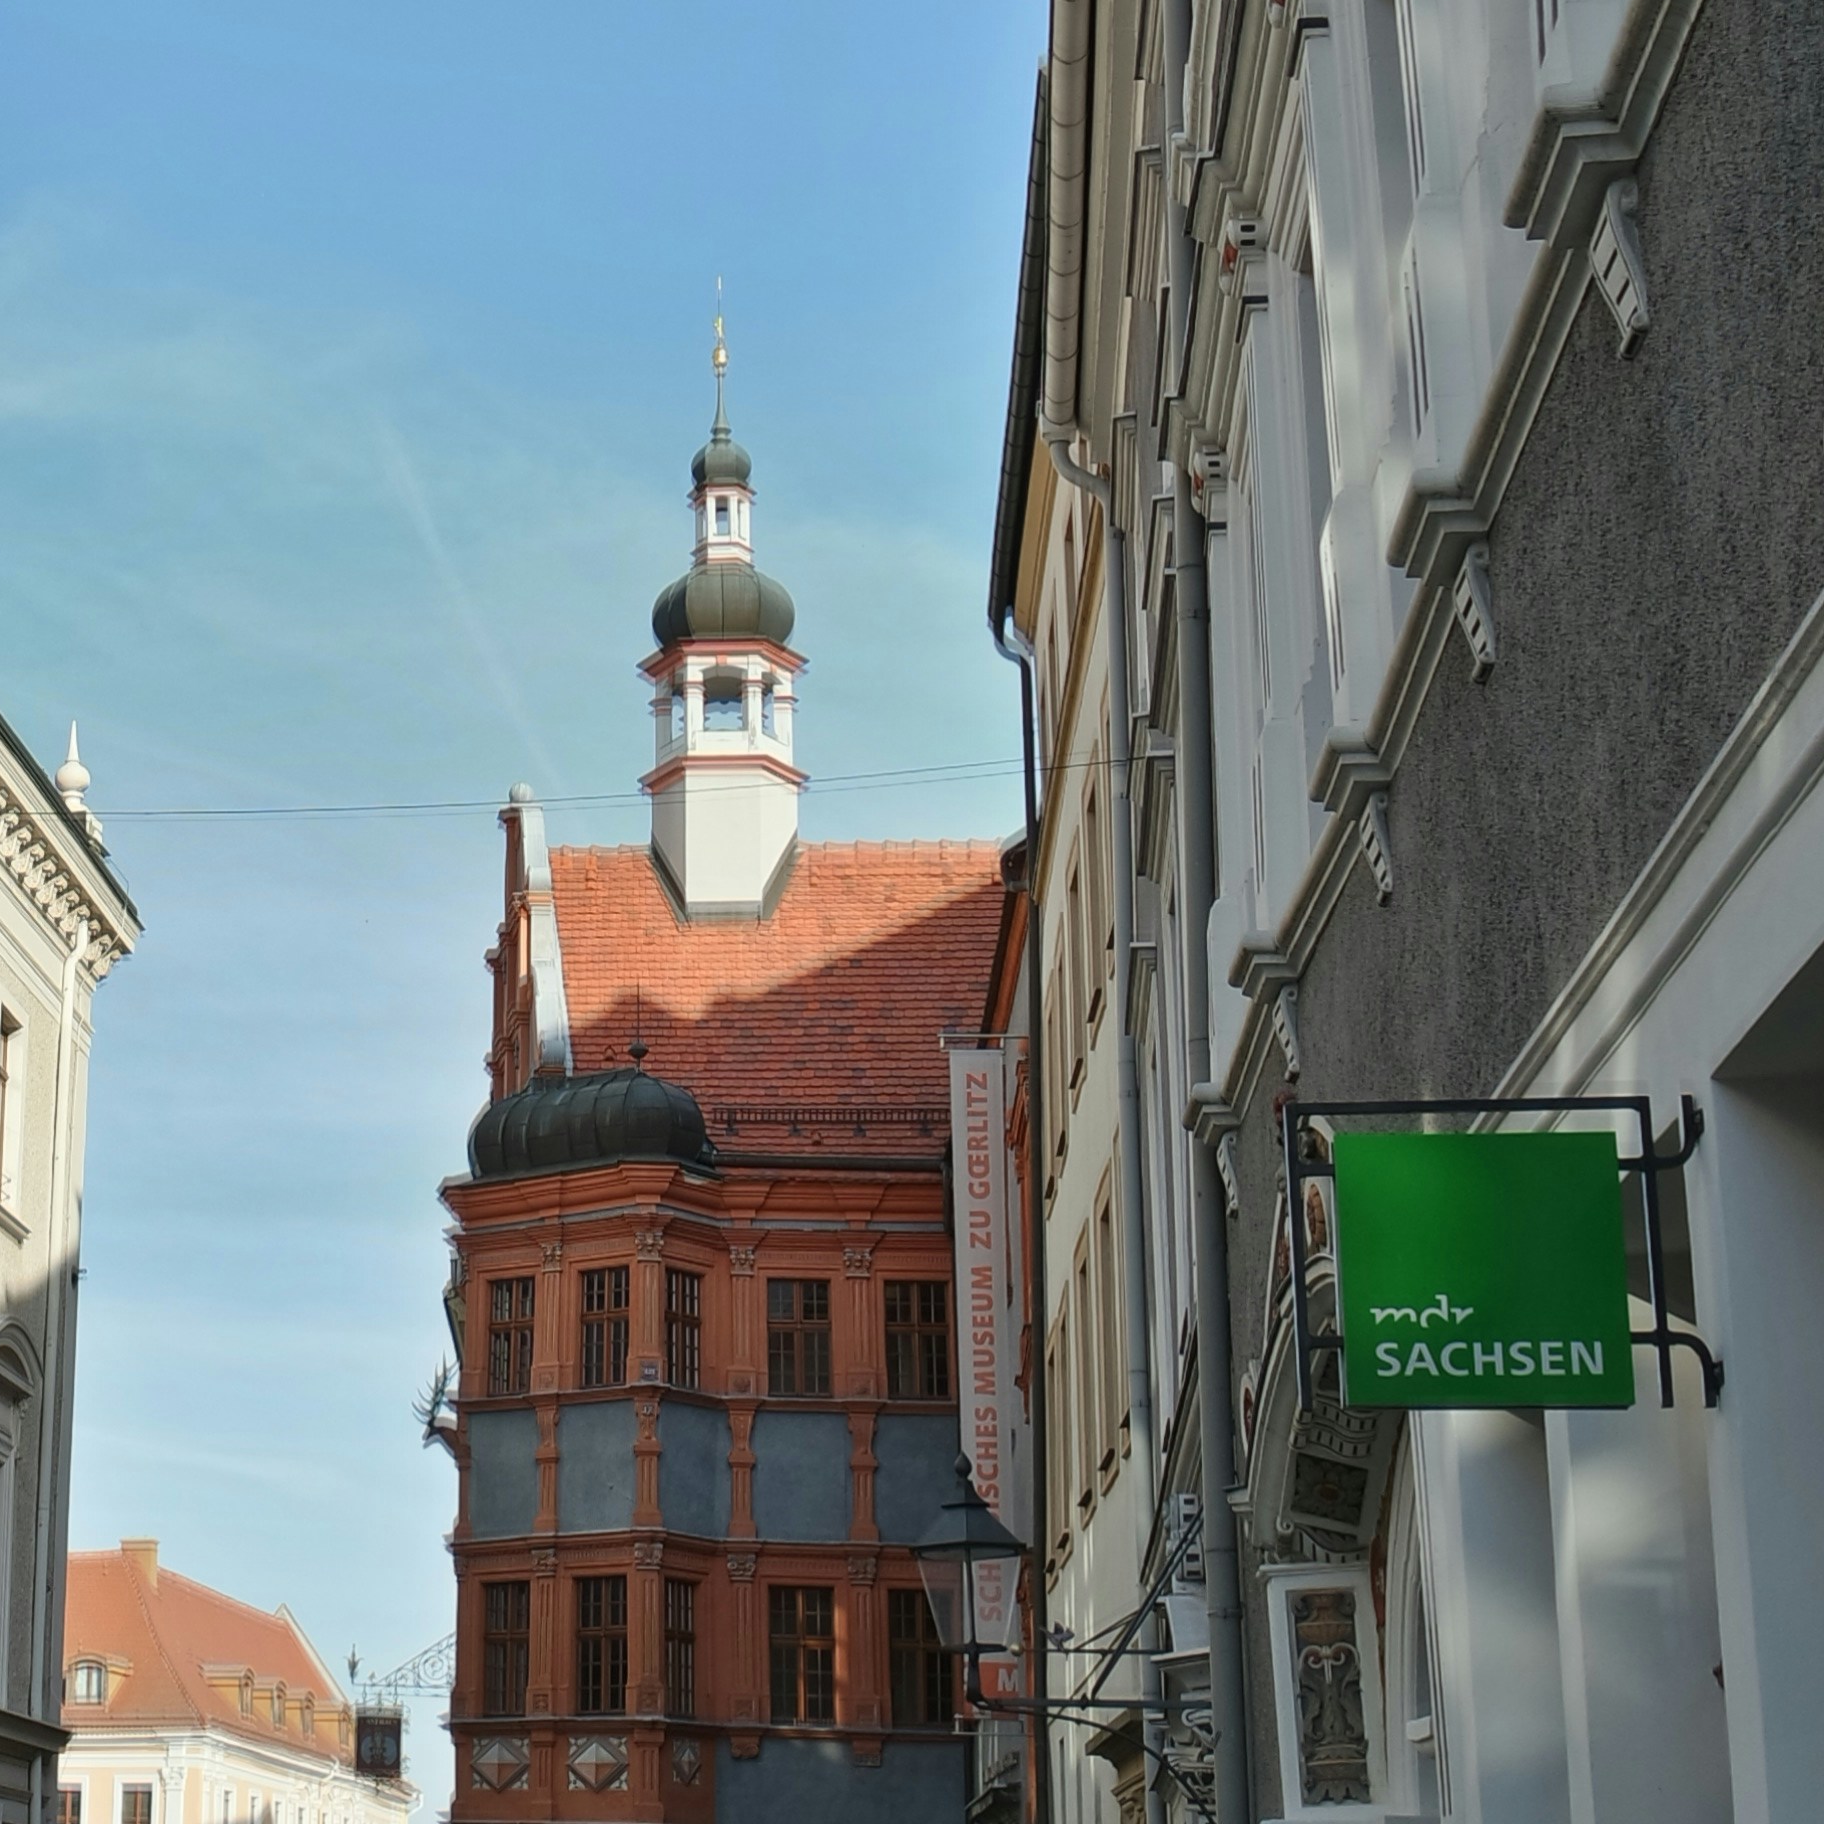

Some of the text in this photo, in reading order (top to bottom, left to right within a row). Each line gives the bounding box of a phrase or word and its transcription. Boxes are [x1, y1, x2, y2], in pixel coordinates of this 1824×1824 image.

[1369, 1294, 1474, 1328] mdr
[966, 1072, 1002, 1622] SCHSCHES MUSEUM ZU GŒRLITZ
[1375, 1341, 1604, 1377] SACHSEN
